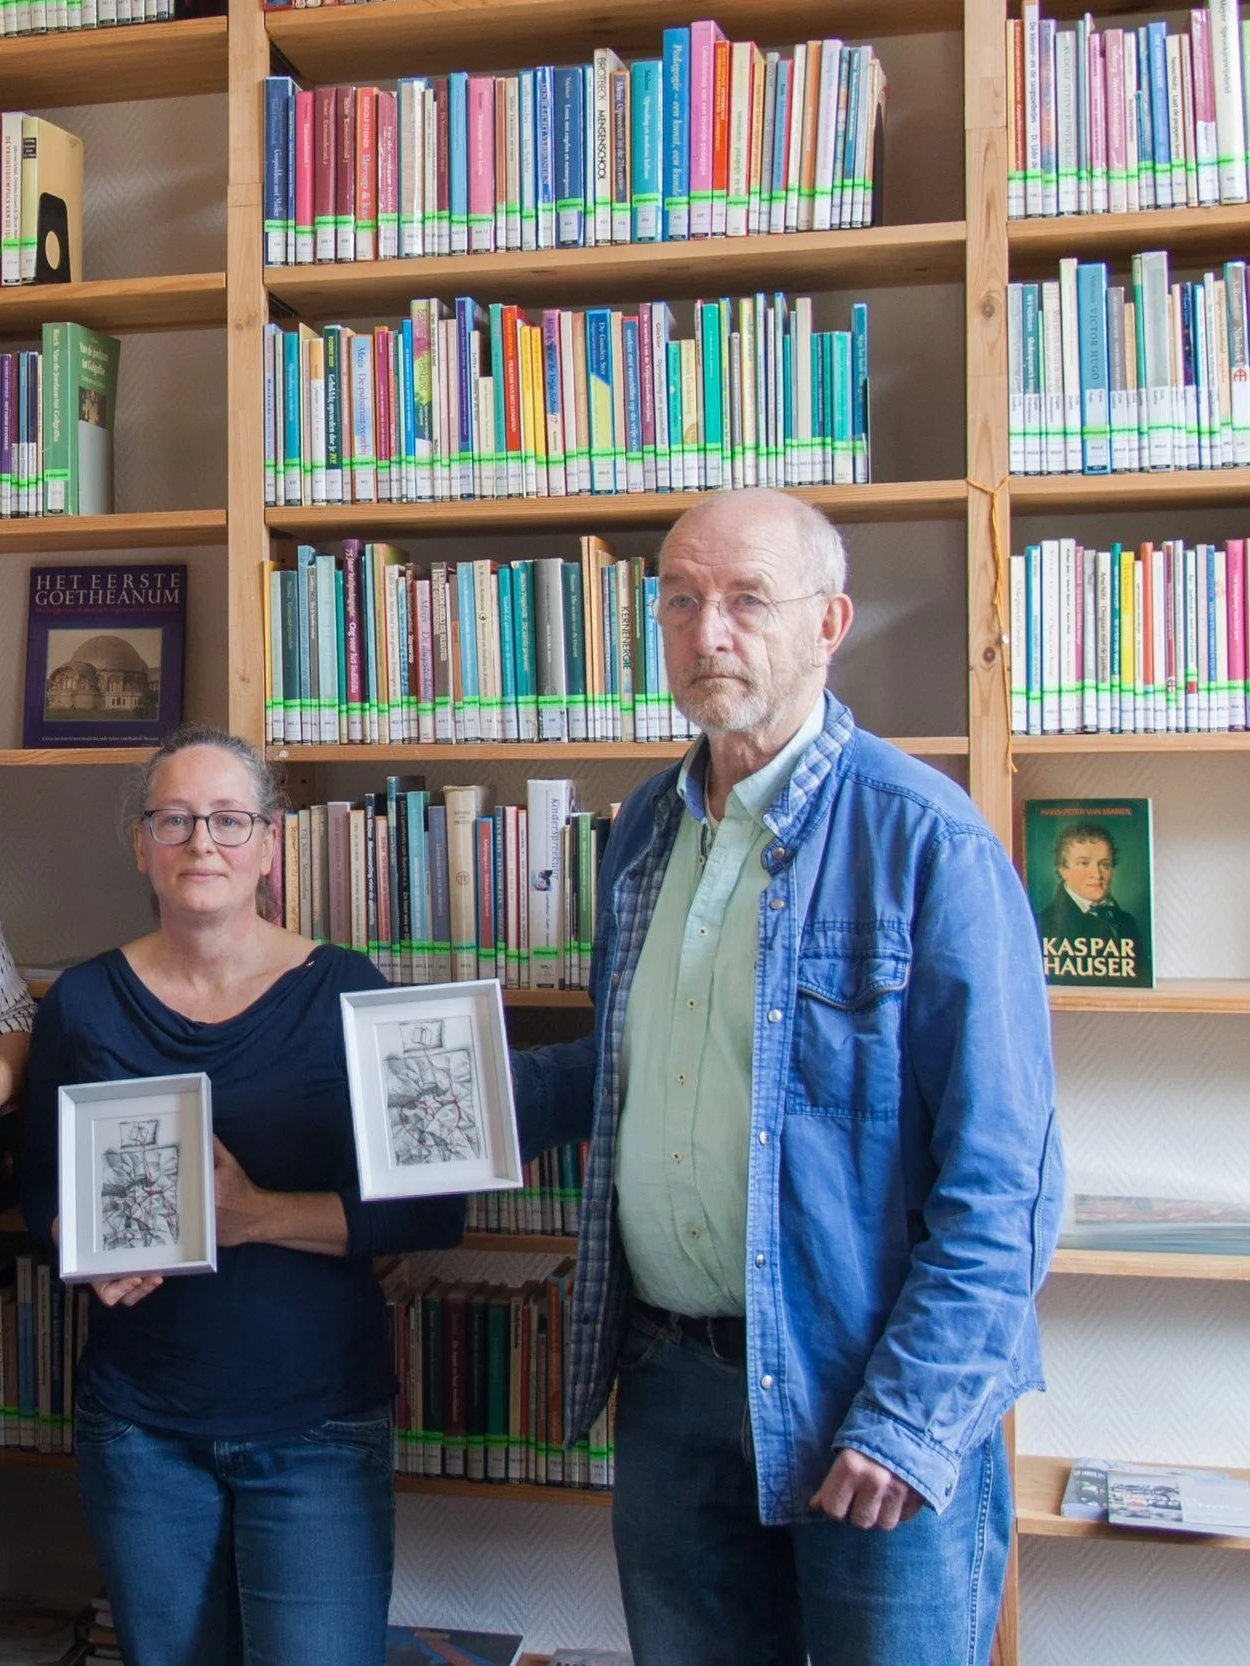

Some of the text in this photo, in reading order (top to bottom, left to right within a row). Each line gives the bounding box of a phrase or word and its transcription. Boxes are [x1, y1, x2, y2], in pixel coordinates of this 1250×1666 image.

[1029, 22, 1036, 30] De
[1030, 70, 1037, 78] de
[597, 57, 606, 181] BROTBECK MENSENSCHOOL
[671, 44, 682, 197] Pedagogie een kunst, een kunde
[1063, 121, 1071, 144] OVER
[362, 192, 370, 200] &
[599, 322, 606, 332] De
[1090, 351, 1099, 380] HUGO
[357, 346, 368, 455] Meijs De puberteit voorbij
[628, 402, 635, 411] op
[328, 444, 336, 452] je
[37, 573, 180, 590] HET EERSTE
[35, 589, 179, 605] GOETHEANUM
[348, 622, 356, 637] Oog
[622, 606, 631, 670] KERNENERGIE
[350, 653, 358, 664] het
[550, 798, 560, 880] Kinderspreekuur
[1043, 937, 1136, 957] KASPAR
[1043, 957, 1136, 977] HAUSER
